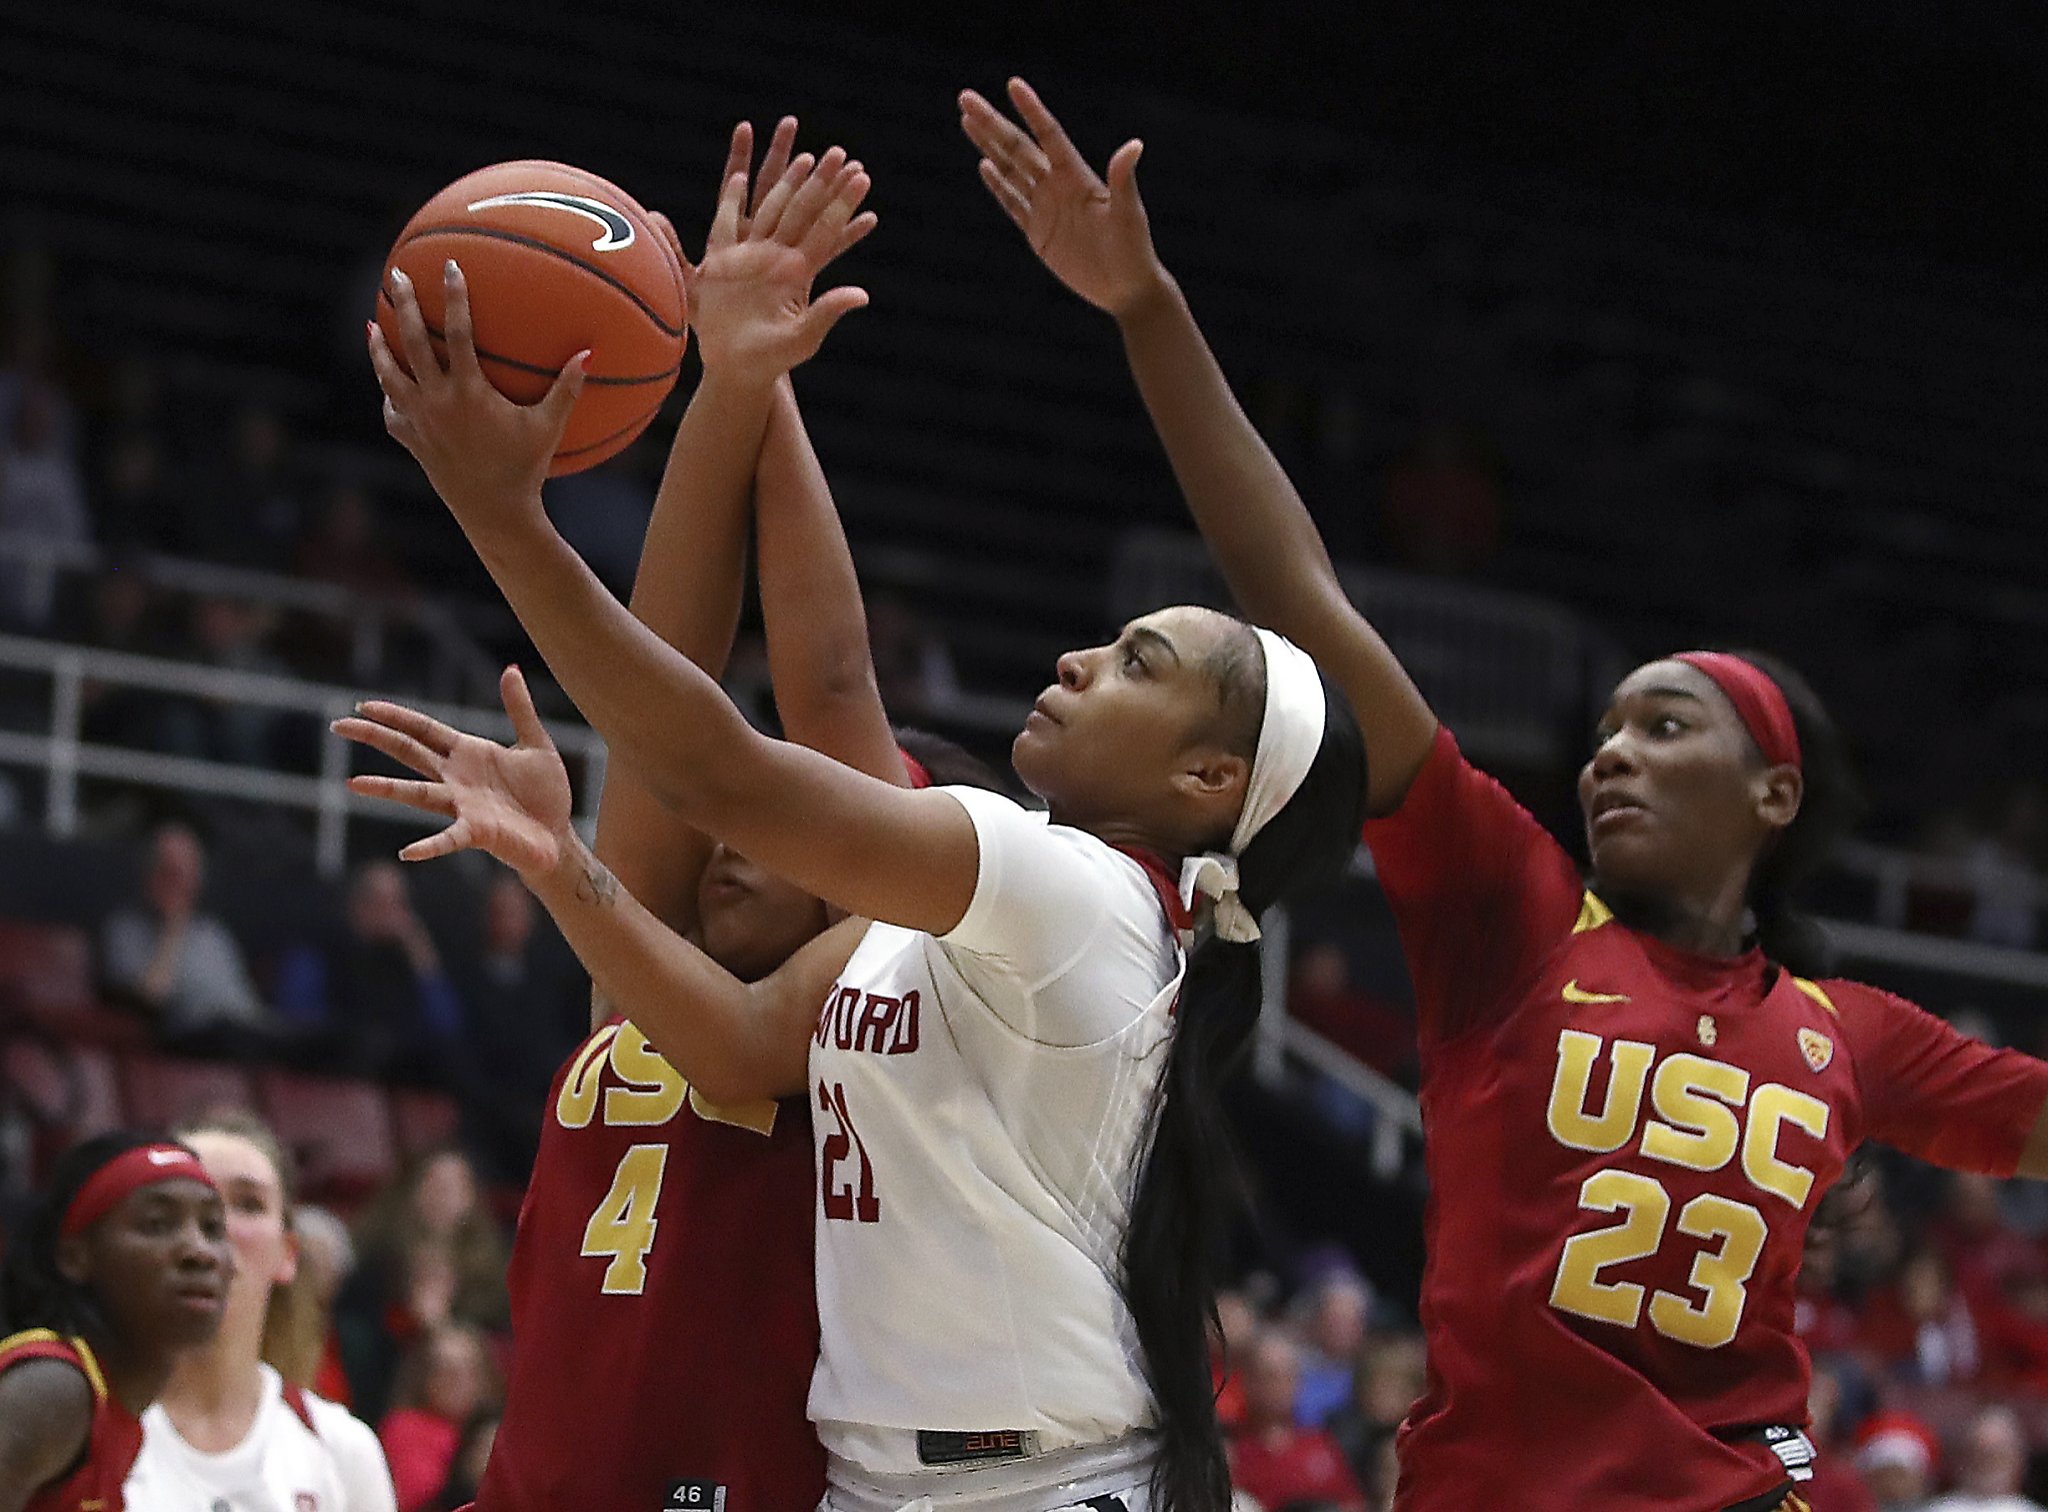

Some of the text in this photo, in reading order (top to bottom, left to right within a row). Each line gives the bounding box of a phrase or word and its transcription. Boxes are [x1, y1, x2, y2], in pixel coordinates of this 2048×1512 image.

[819, 1077, 880, 1222] 21
[1547, 1029, 1829, 1210] USC
[580, 1144, 669, 1295] 4
[1549, 1169, 1768, 1349] 23
[672, 1485, 702, 1503] 46
